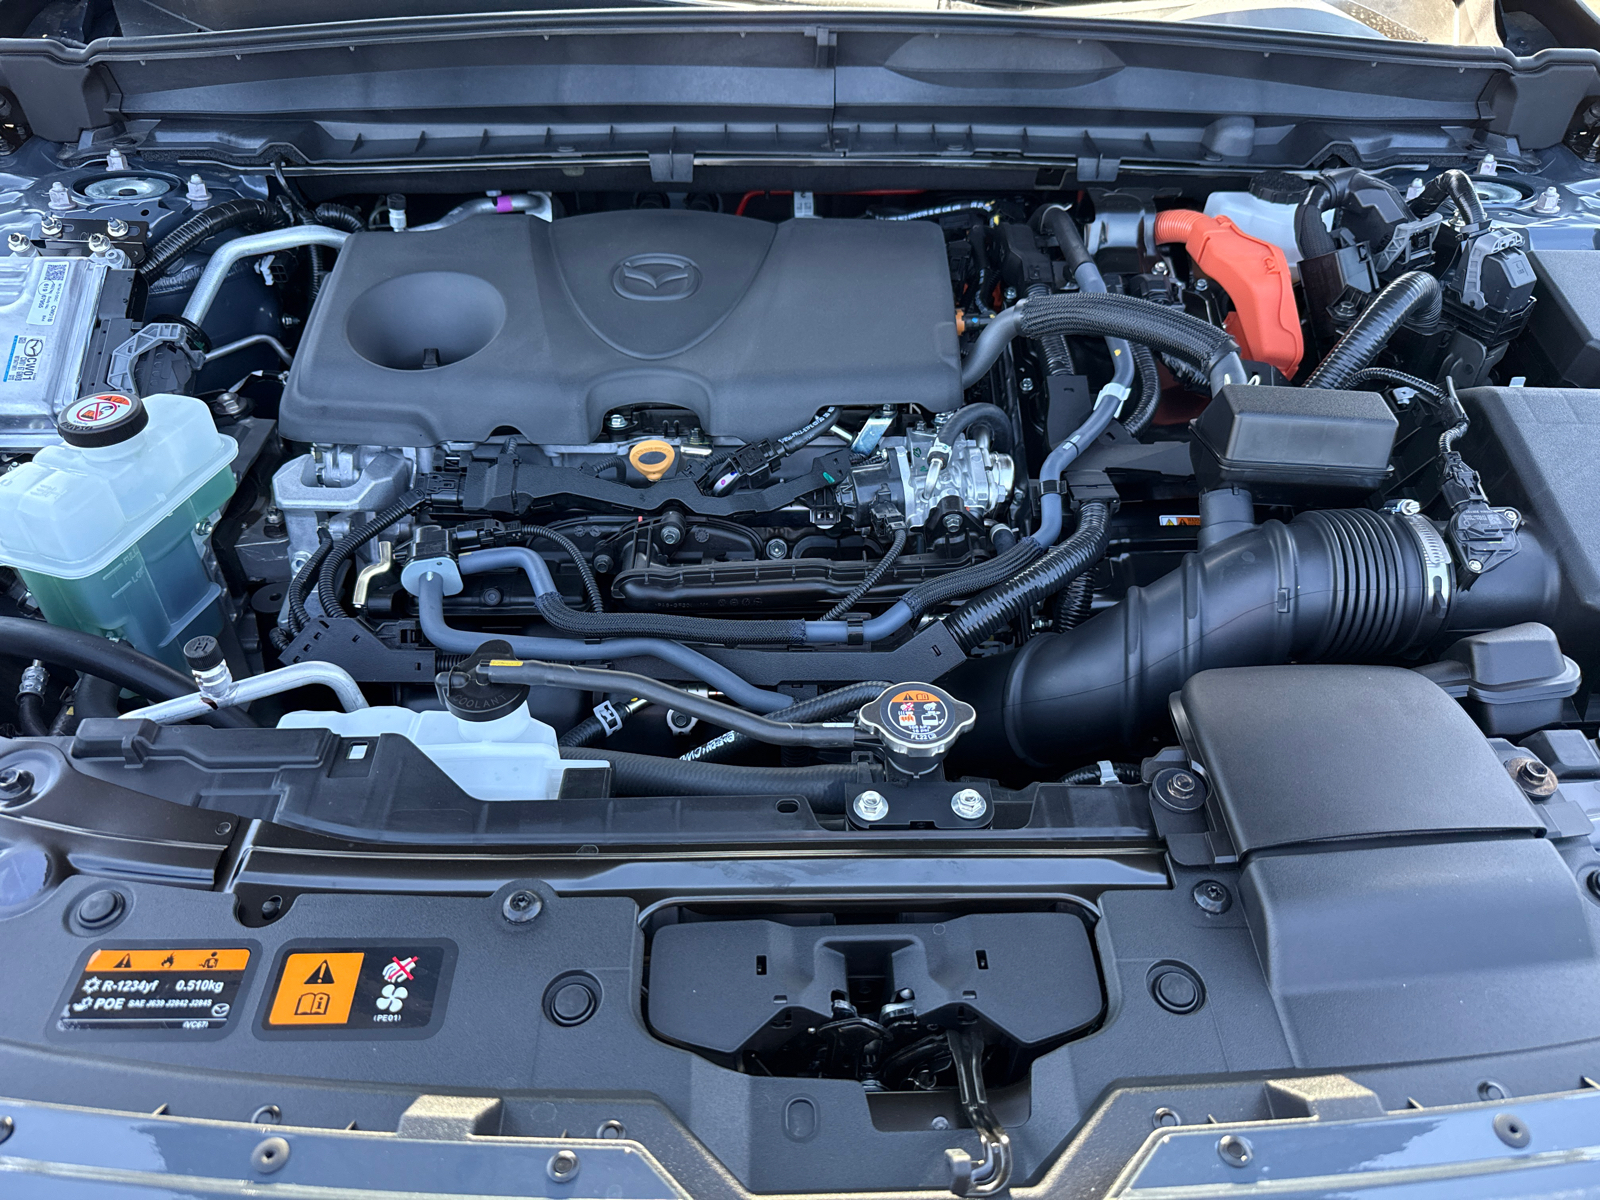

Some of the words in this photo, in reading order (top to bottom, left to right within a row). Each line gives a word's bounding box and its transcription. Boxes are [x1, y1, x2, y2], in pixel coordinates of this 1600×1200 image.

[22, 357, 37, 381] CW01
[453, 692, 507, 709] COOLANT
[101, 979, 159, 995] R-1234yf
[175, 979, 224, 994] 0.510kg
[93, 997, 126, 1010] POE
[127, 999, 146, 1009] SAE
[145, 999, 166, 1009] J639
[165, 999, 189, 1009] J2842
[188, 999, 213, 1009] J2845
[373, 1014, 402, 1022] (PE01)
